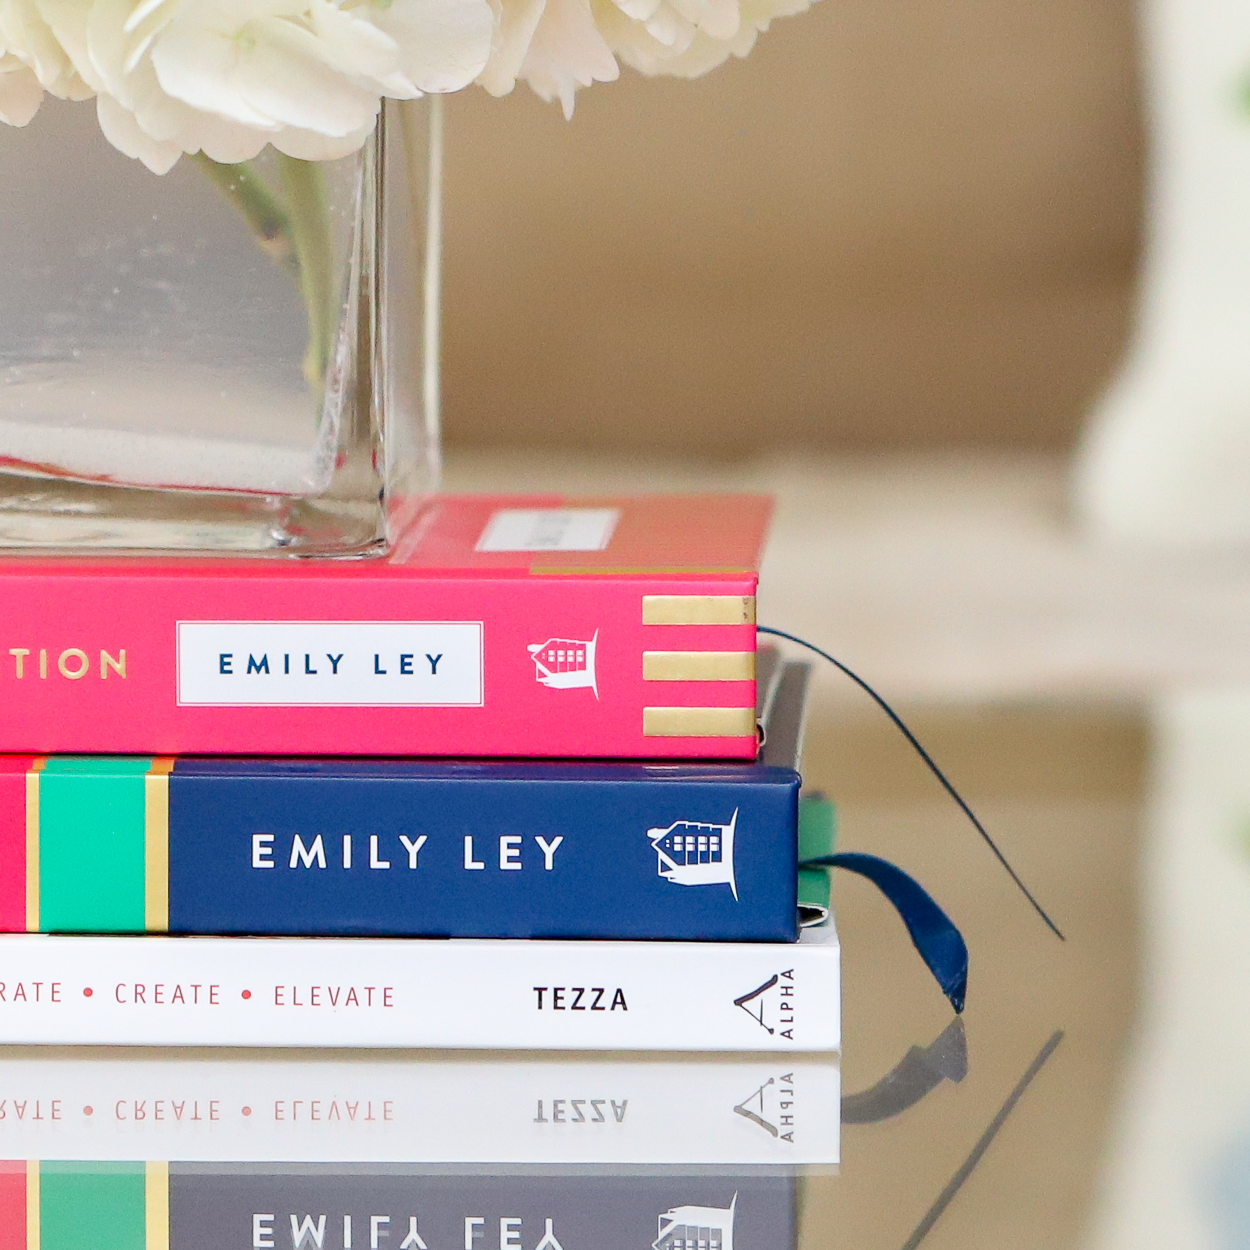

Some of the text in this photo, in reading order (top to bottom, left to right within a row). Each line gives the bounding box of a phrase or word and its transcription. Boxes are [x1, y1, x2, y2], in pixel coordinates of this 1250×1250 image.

[219, 653, 443, 675] EMILY LEY
[252, 833, 564, 871] EMILY LEY
[115, 983, 220, 1006] CREATE
[274, 985, 395, 1008] ELEVATE
[532, 986, 628, 1012] TEZZA
[779, 968, 795, 1040] ALPHA
